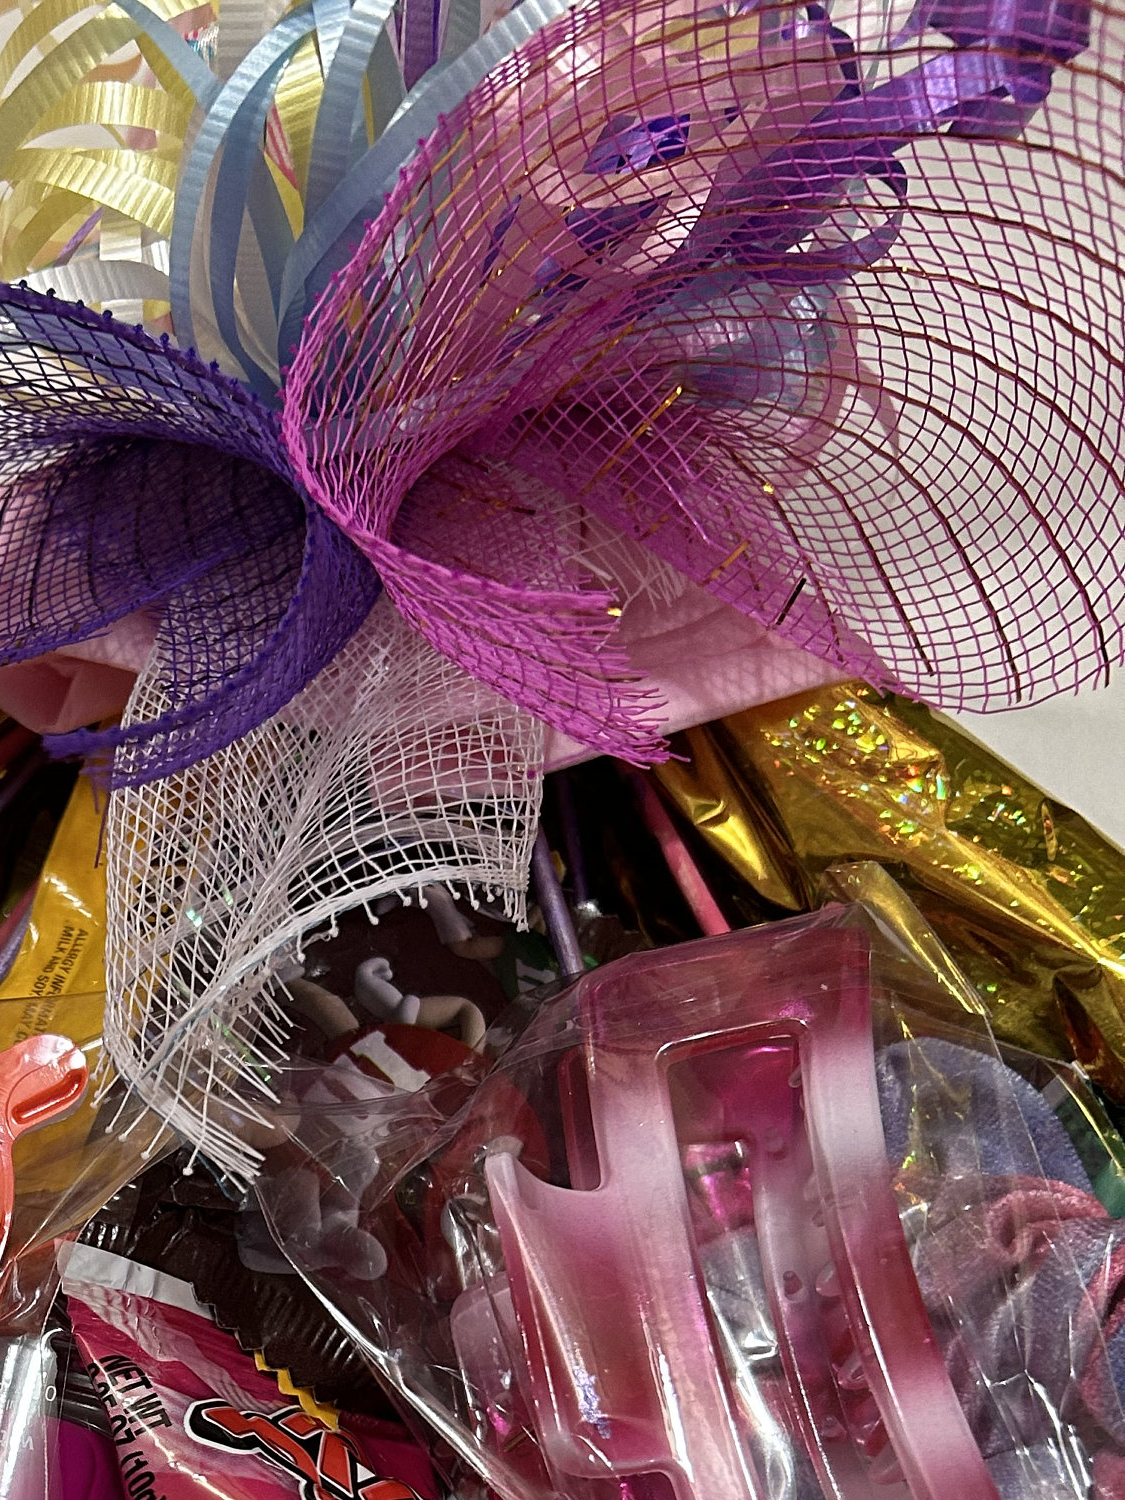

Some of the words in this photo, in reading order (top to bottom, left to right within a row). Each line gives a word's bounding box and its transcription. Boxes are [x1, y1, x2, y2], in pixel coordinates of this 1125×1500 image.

[56, 925, 75, 955] MILK
[42, 955, 59, 975] AND
[99, 1354, 153, 1404] NET
[124, 1392, 173, 1436] WT
